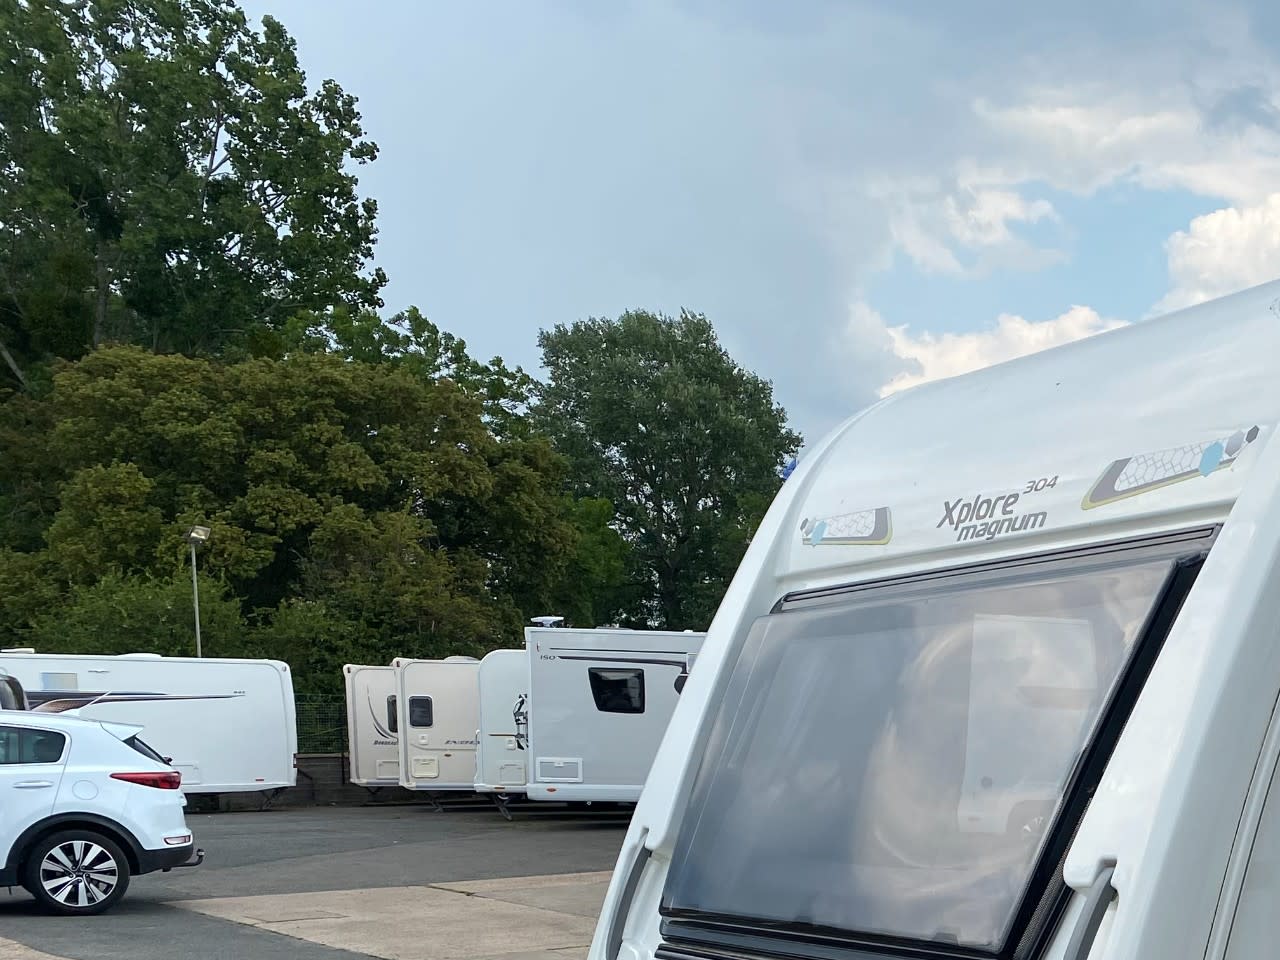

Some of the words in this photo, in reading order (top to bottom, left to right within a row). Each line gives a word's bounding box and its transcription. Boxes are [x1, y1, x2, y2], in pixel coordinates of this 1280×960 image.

[936, 494, 1020, 531] Xplore
[1023, 476, 1059, 495] 304
[957, 511, 1048, 542] magnum
